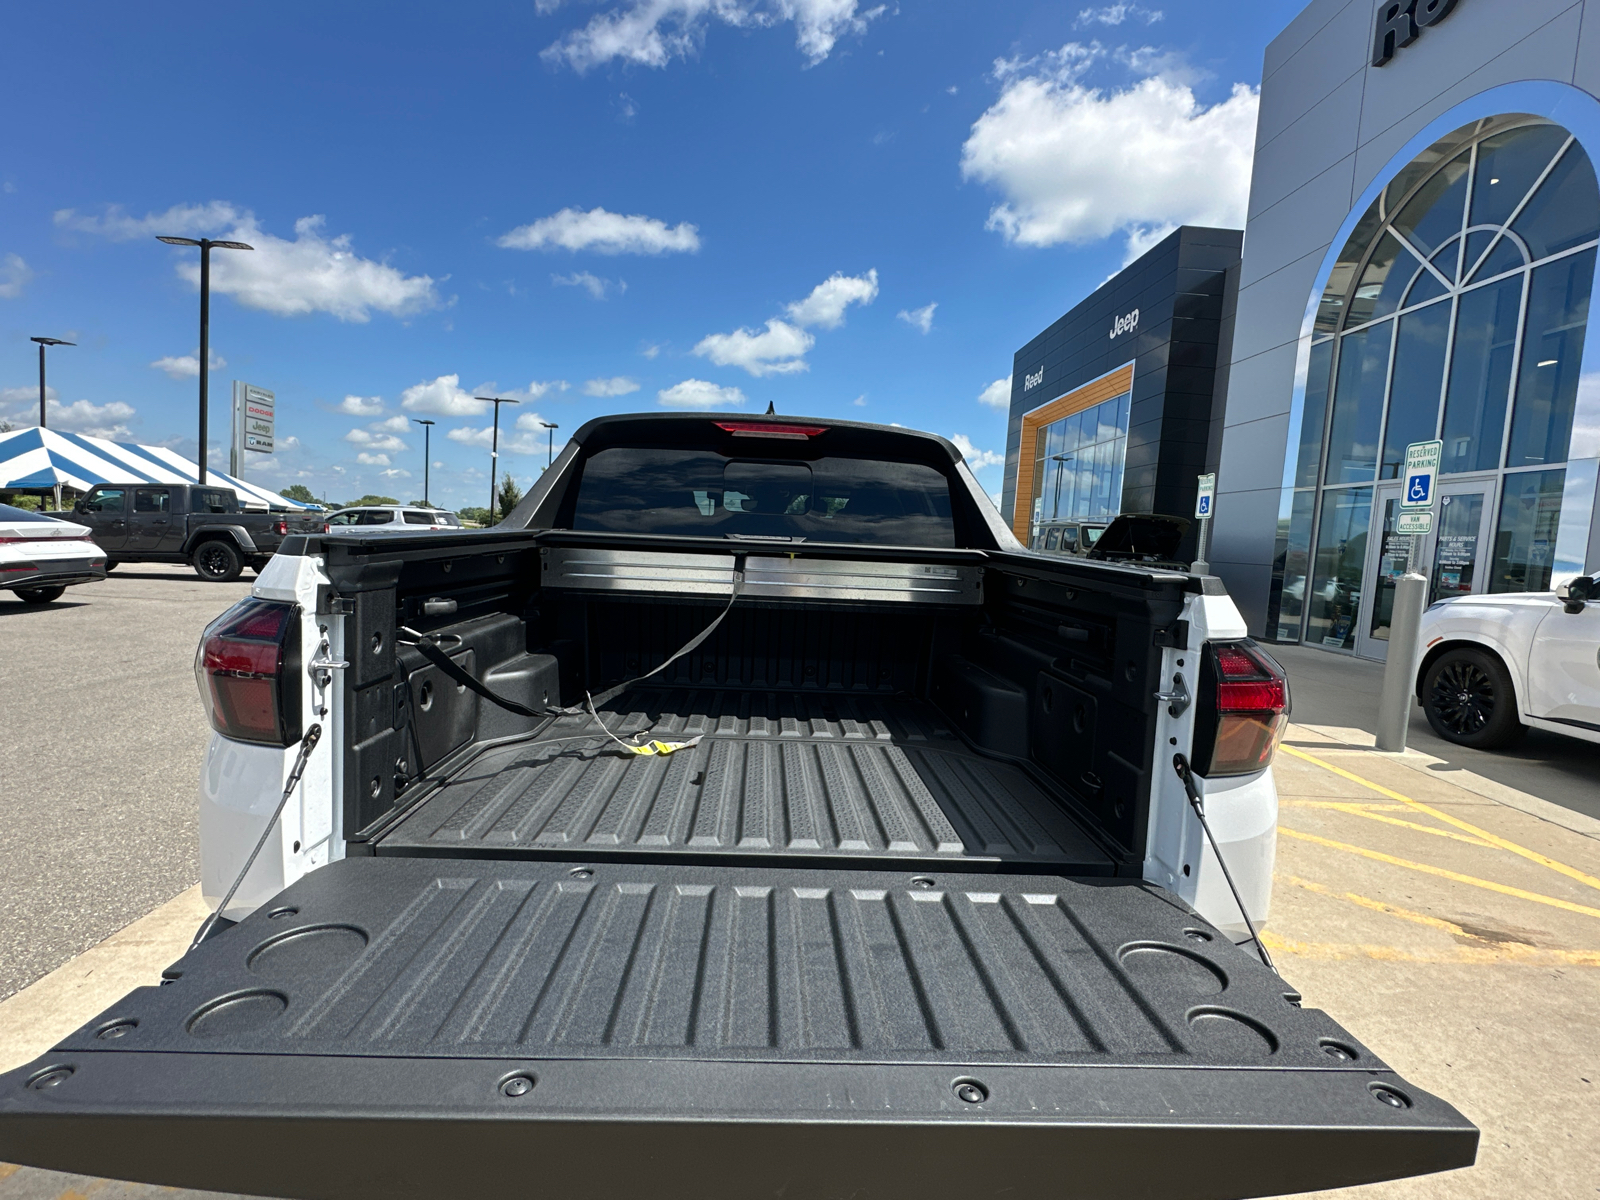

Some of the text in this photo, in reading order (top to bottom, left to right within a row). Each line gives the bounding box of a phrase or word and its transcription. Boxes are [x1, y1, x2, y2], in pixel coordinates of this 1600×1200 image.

[1109, 308, 1139, 340] Jeep
[1024, 365, 1044, 392] Reed
[248, 406, 274, 417] DODGE
[252, 421, 271, 434] Jeep
[256, 440, 273, 448] RAM
[1409, 447, 1437, 458] RESERVED
[1407, 458, 1436, 469] PARKING
